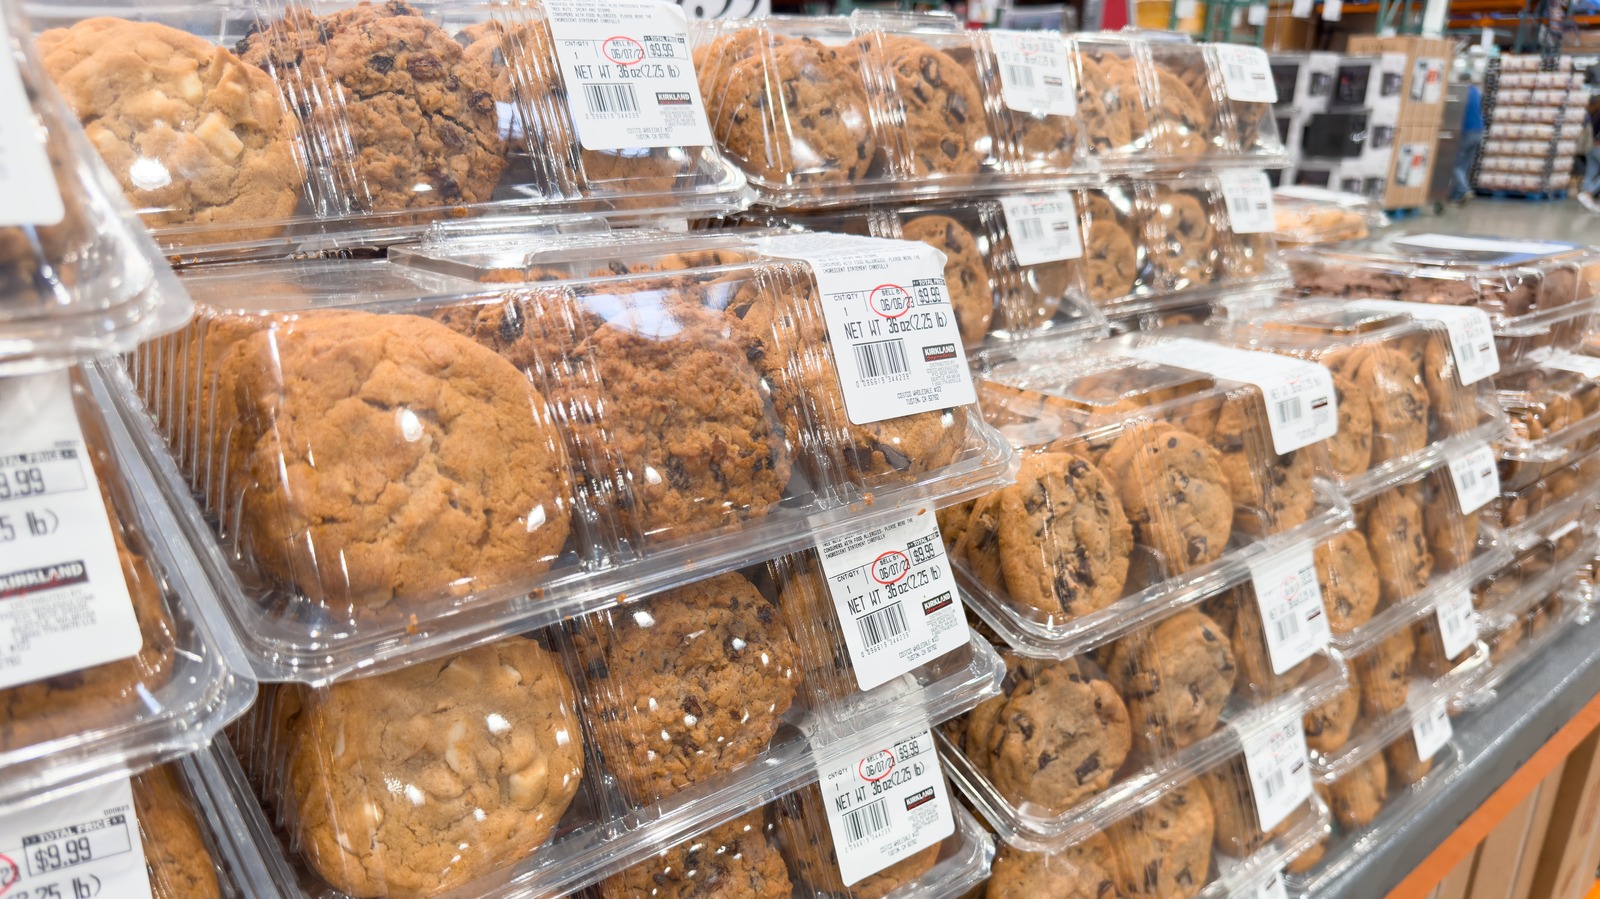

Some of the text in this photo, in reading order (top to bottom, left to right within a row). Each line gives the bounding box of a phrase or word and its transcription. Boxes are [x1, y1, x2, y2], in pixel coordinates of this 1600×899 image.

[650, 43, 674, 57] $9.99
[575, 66, 594, 79] NET
[600, 66, 611, 79] WT
[668, 65, 680, 78] lb)
[880, 296, 915, 311] 06/06/23
[918, 287, 941, 303] $9.99
[844, 307, 848, 316] 1
[844, 321, 865, 340] NET
[870, 319, 881, 336] WT
[935, 313, 948, 328] lb)
[924, 345, 954, 356] KIRKLAND
[26, 508, 59, 536] lb)
[913, 543, 935, 562] $9.99
[879, 559, 911, 580] 06/07/23
[847, 585, 851, 594] 1
[848, 596, 866, 615] NET
[870, 589, 881, 605] WT
[929, 565, 941, 582] lb)
[924, 593, 950, 609] KIRKLAND
[899, 740, 920, 759] $9.99
[835, 792, 852, 812] NET
[855, 786, 867, 803] WT
[914, 761, 925, 776] lb)
[41, 819, 111, 843] TOTAL PRICE
[35, 836, 92, 872] $9.99
